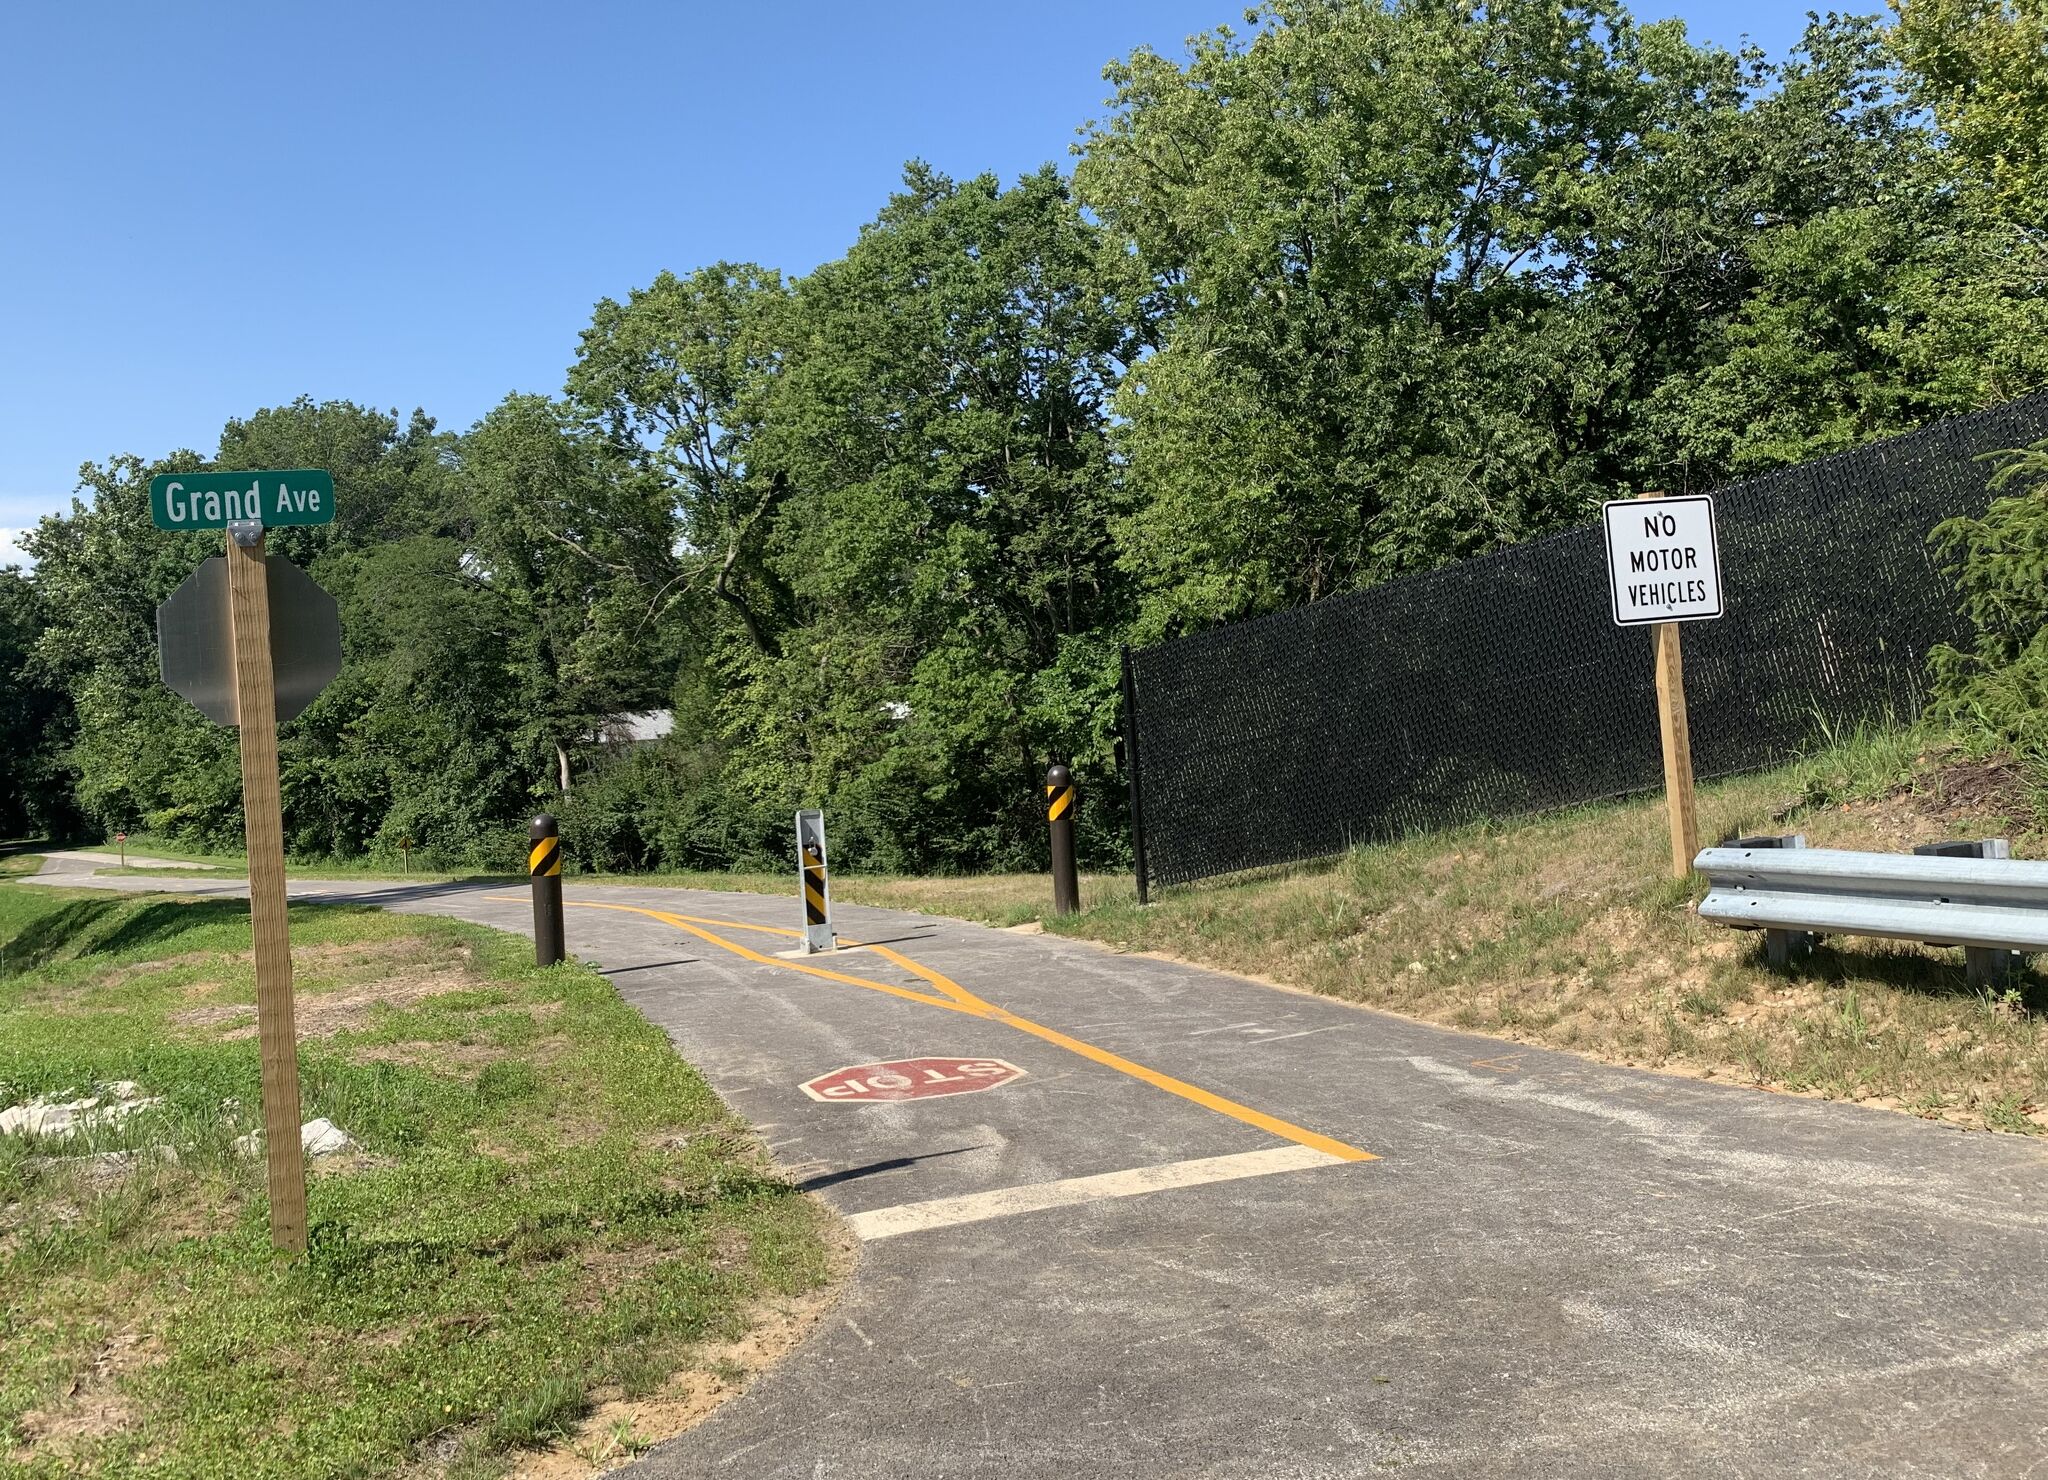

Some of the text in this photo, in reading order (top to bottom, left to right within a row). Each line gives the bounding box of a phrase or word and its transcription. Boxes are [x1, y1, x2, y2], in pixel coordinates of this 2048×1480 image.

[166, 480, 321, 522] Grand Ave
[1644, 514, 1676, 538] NO
[1630, 547, 1697, 573] MOTOR
[1628, 580, 1706, 607] VEHICLES
[822, 1062, 1007, 1097] STOP
